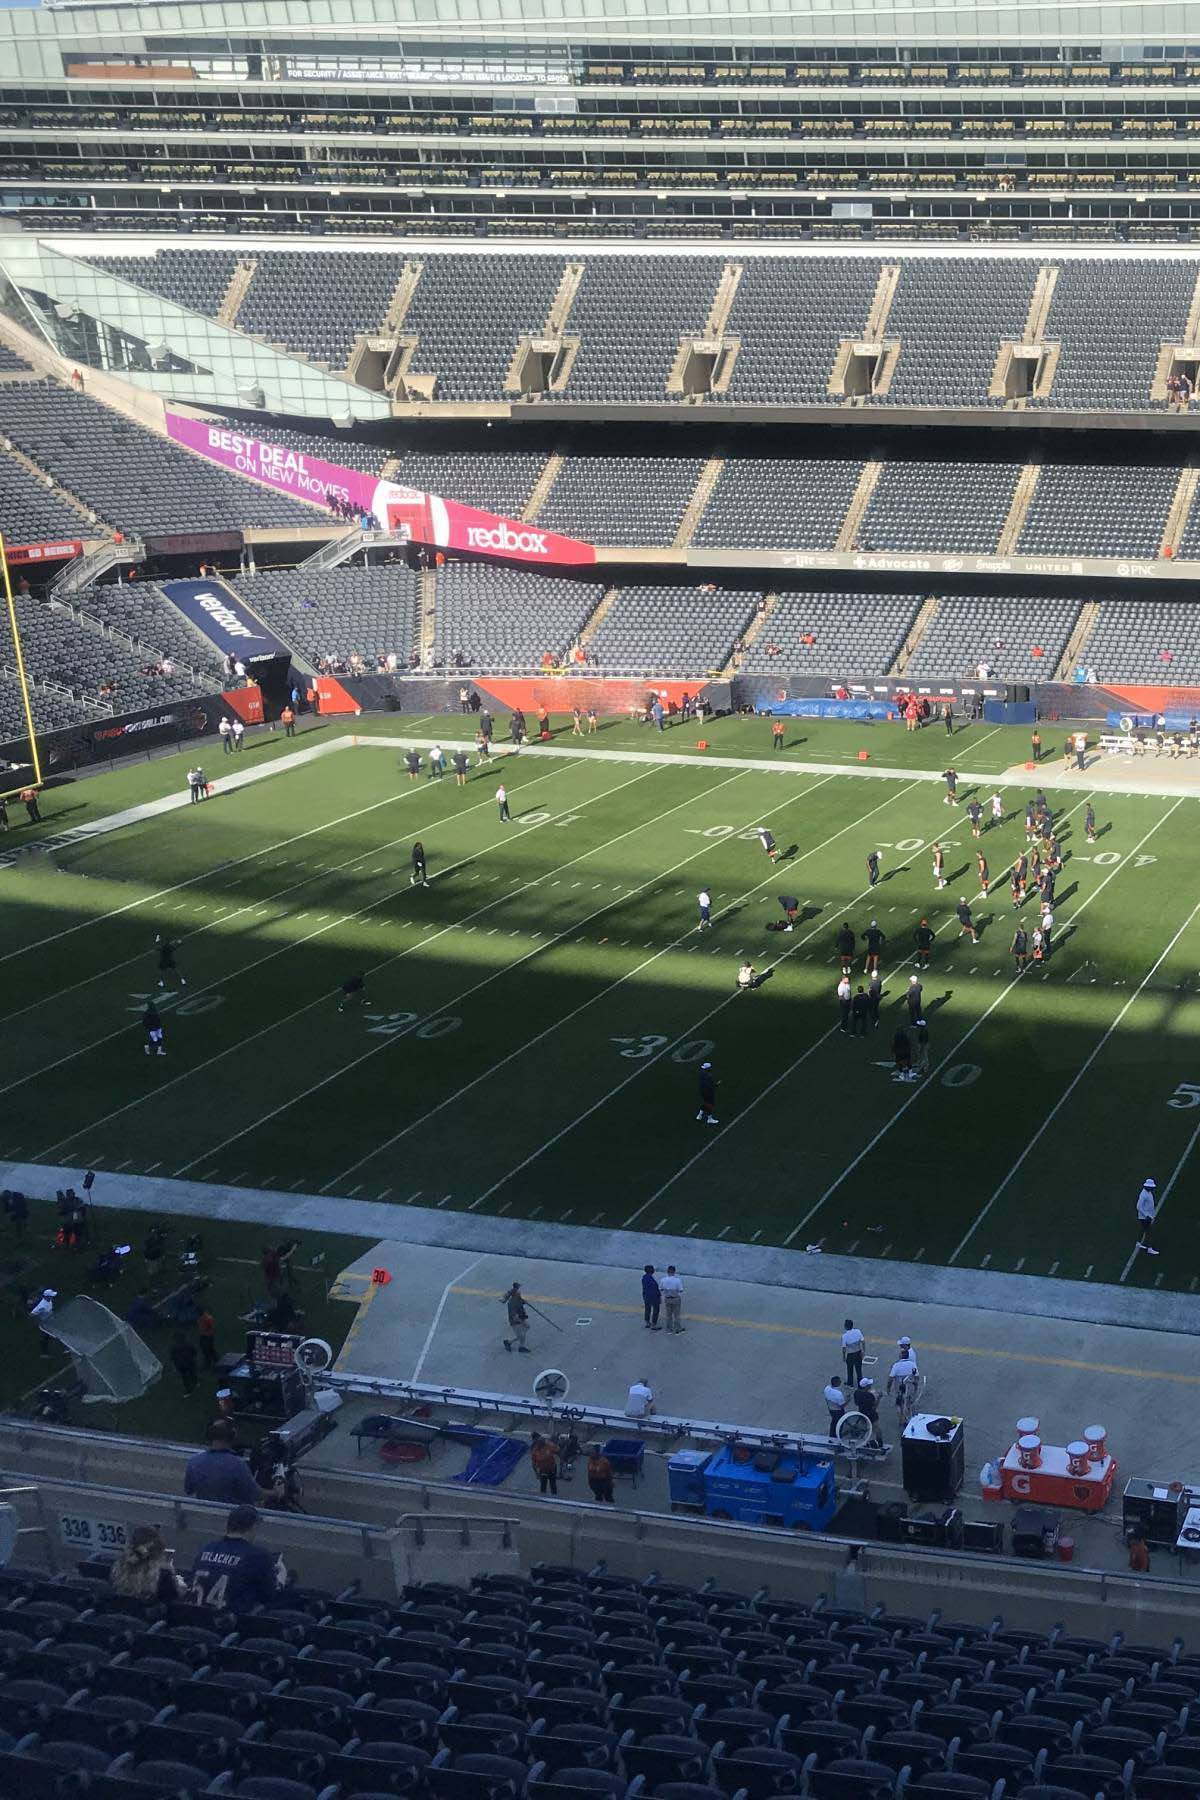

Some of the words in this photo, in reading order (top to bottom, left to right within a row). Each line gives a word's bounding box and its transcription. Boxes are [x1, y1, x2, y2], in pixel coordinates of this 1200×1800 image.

[208, 428, 254, 457] BEST
[260, 444, 308, 475] DEAL
[235, 455, 256, 473] ON
[261, 464, 294, 484] NEW
[298, 476, 349, 502] MOVIES
[467, 523, 548, 554] redbox
[868, 558, 930, 569] Advocate
[1025, 564, 1070, 572] UNITED
[1131, 565, 1155, 576] PNC
[194, 592, 259, 639] verizon
[373, 1269, 385, 1283] 30
[1012, 1474, 1031, 1494] G
[62, 1517, 91, 1539] 338
[98, 1523, 127, 1545] 336
